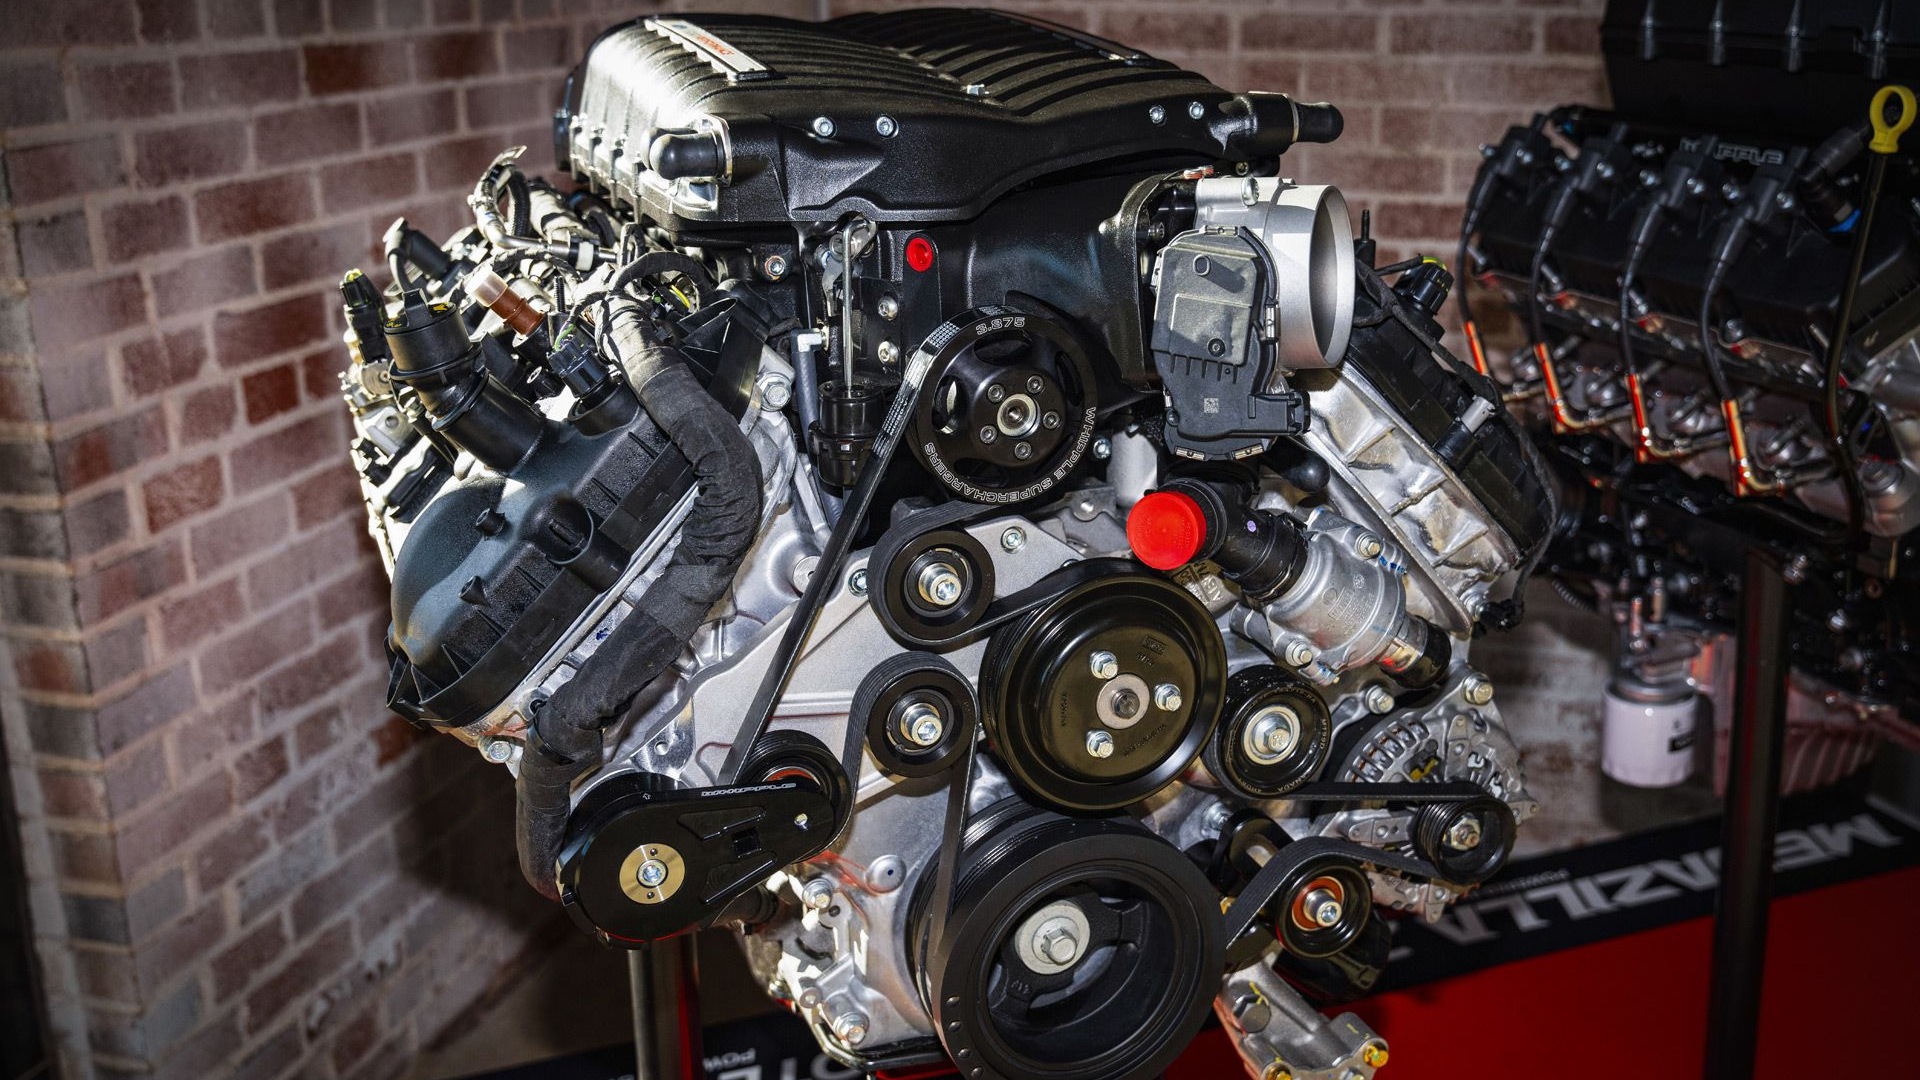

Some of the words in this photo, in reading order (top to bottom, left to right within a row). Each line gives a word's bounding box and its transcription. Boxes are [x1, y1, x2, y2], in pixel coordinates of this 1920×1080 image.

[975, 317, 1026, 335] 3.875
[925, 442, 1053, 503] SUPERCHARGERS
[1053, 406, 1097, 480] WHIPPLE
[1418, 812, 1902, 946] MEAZILLA
